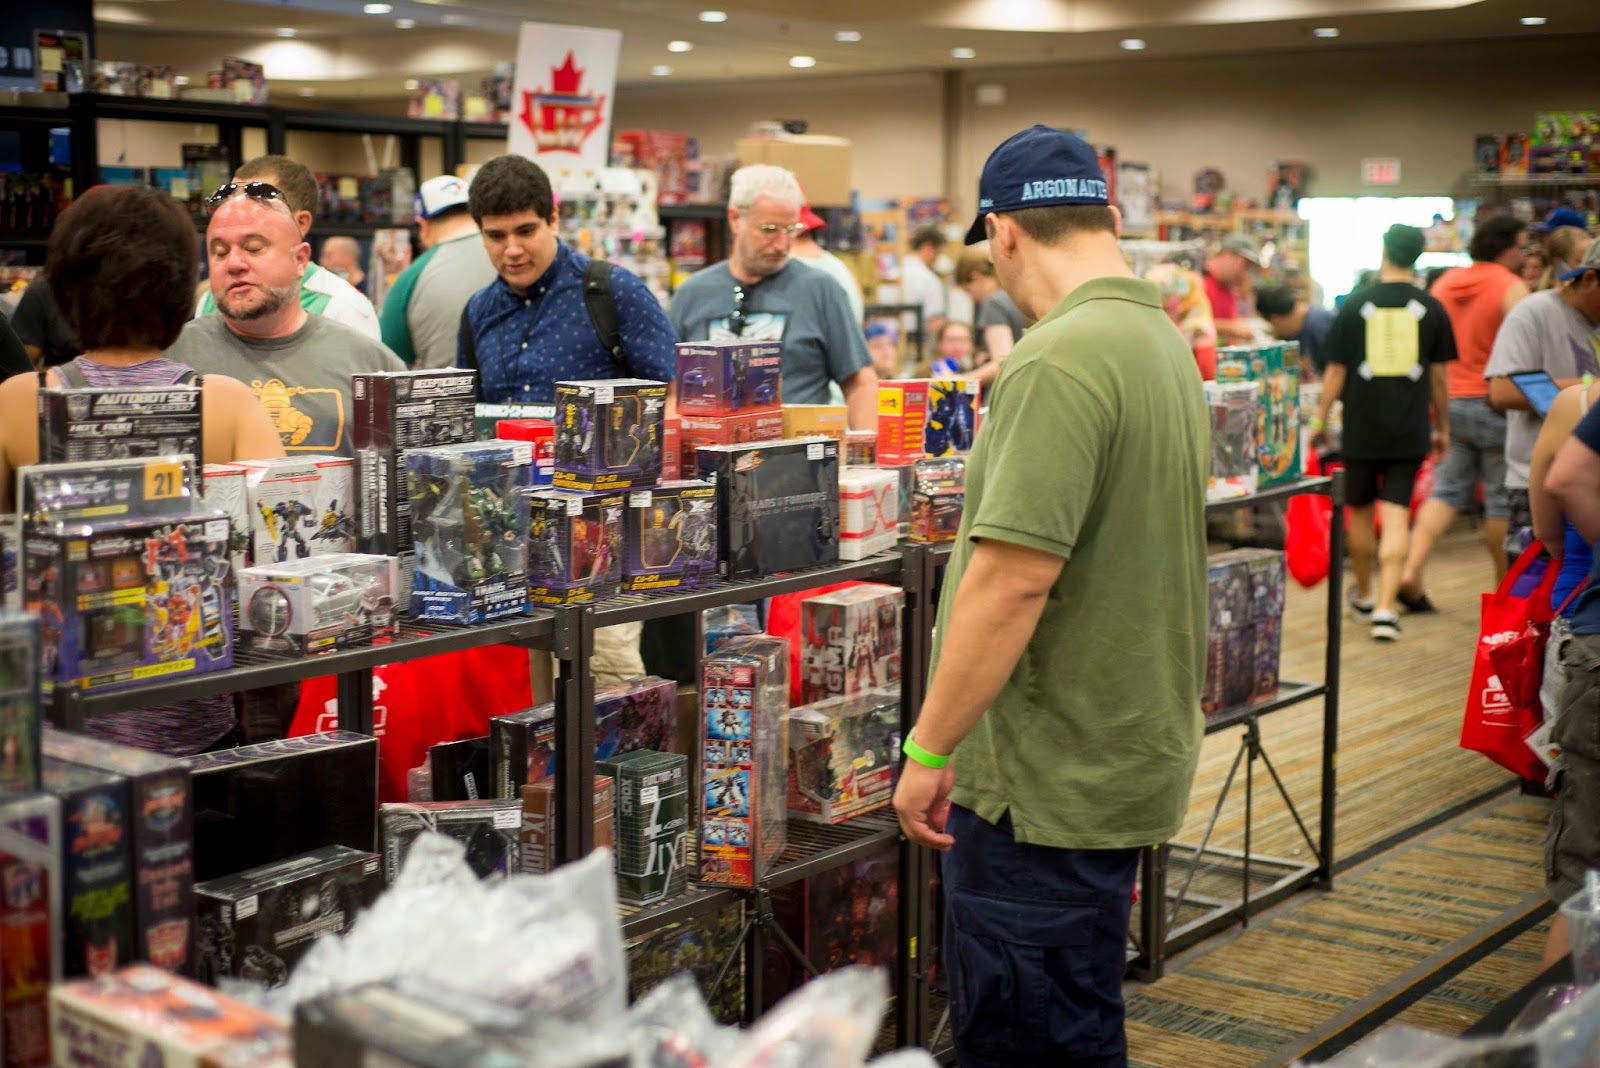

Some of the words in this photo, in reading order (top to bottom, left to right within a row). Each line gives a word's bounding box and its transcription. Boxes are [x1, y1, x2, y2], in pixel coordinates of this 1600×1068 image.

[96, 392, 165, 405] AUTOBOT
[167, 391, 199, 404] SET
[153, 472, 173, 496] 21
[521, 811, 545, 873] ION-X1
